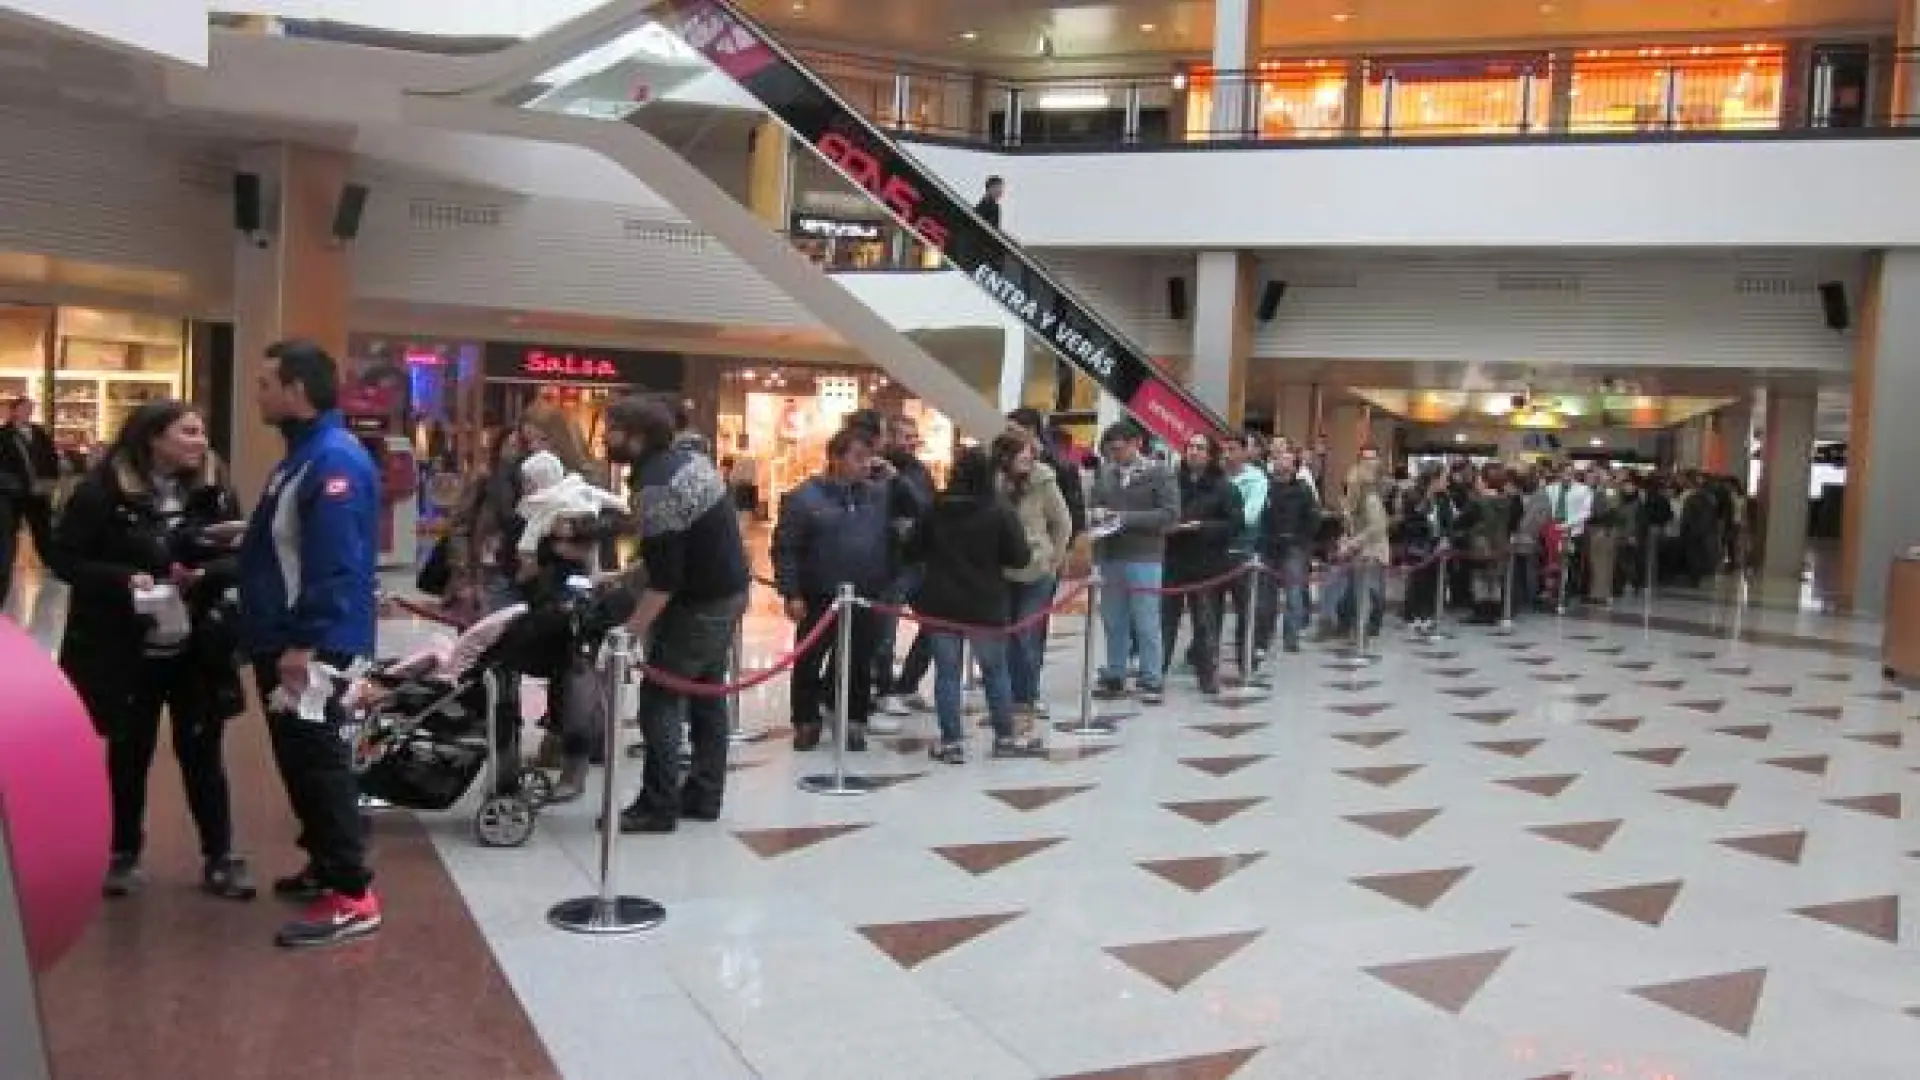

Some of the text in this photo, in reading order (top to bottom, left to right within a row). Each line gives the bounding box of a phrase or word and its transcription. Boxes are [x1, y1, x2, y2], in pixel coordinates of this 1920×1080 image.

[975, 263, 1117, 376] ENTRA Y VERÁS
